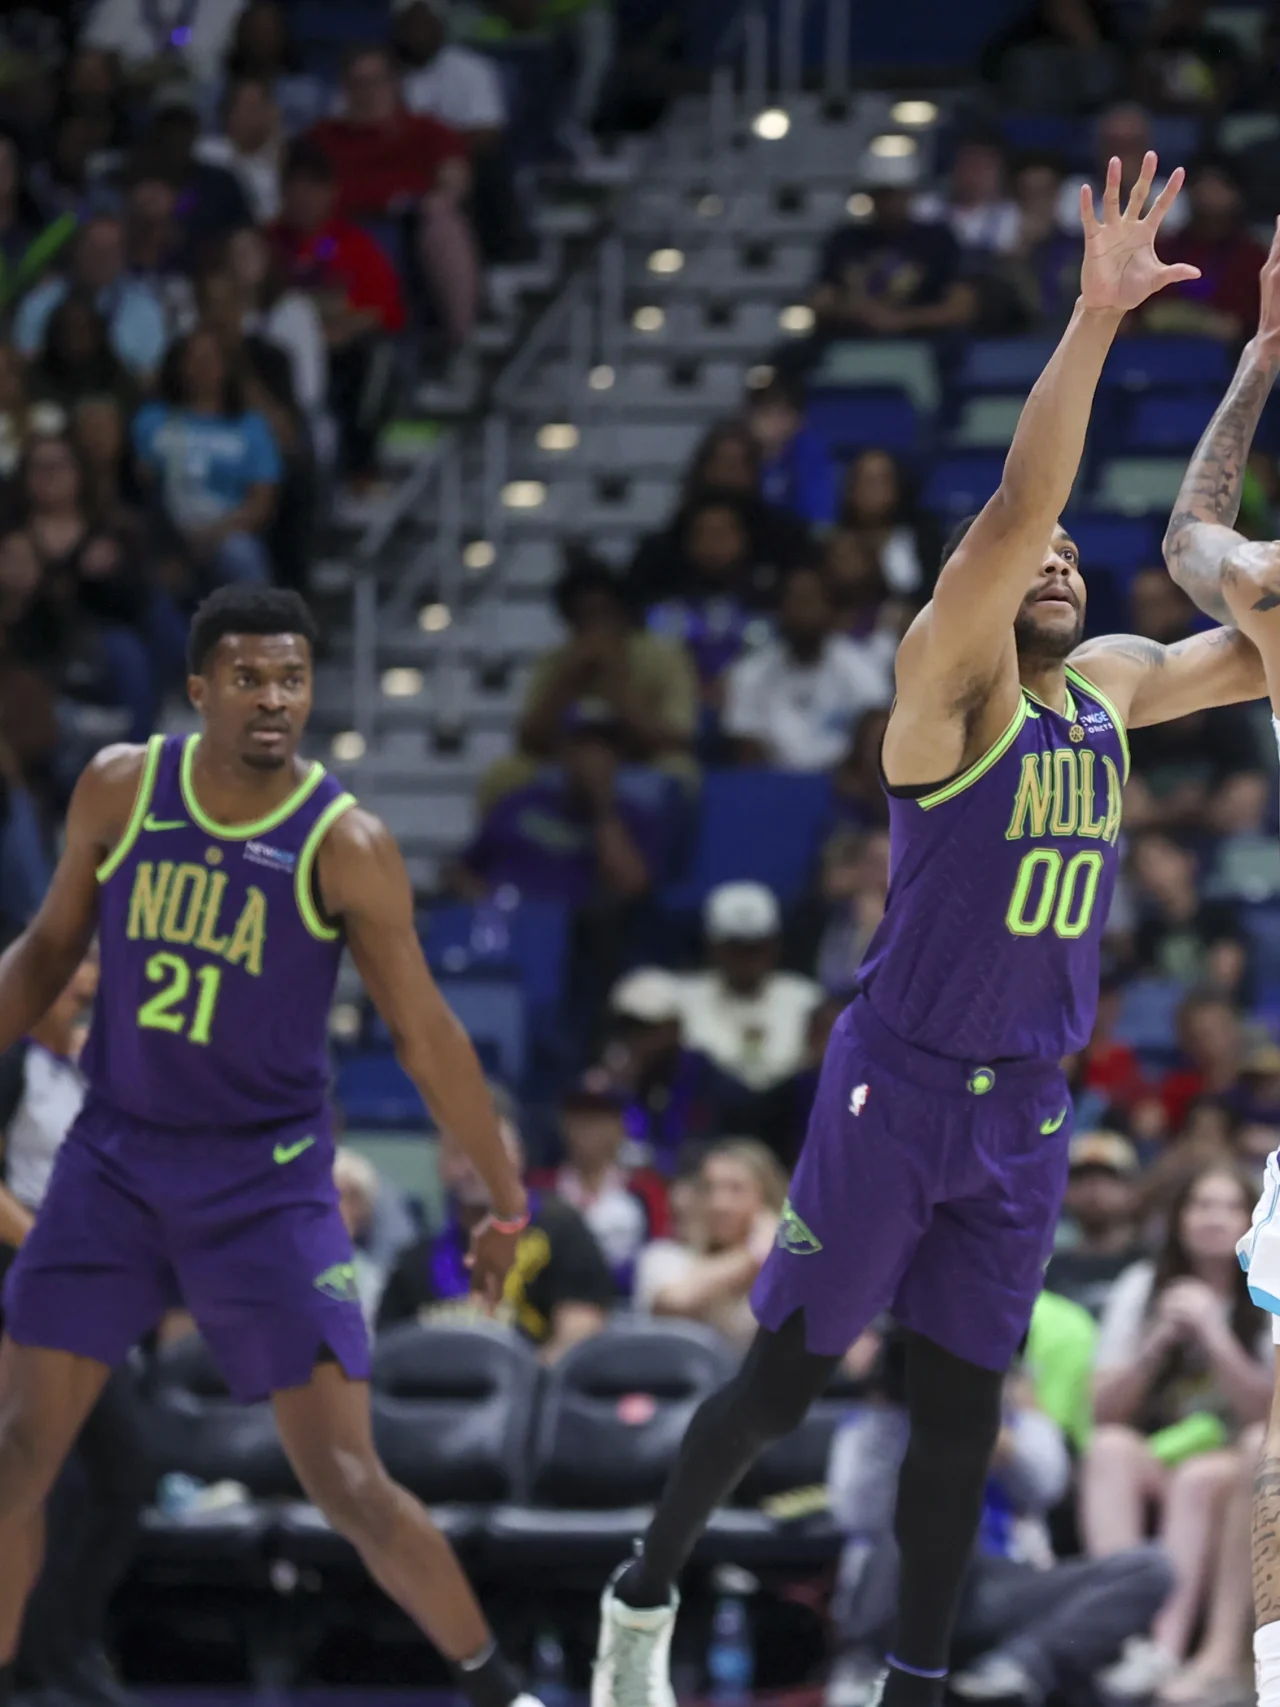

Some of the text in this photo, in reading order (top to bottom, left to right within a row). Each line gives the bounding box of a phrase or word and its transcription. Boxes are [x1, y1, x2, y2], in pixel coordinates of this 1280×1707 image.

[1005, 748, 1123, 847] NOLA
[126, 860, 267, 976] NOLA
[1005, 847, 1104, 939] 00
[137, 951, 221, 1045] 21
